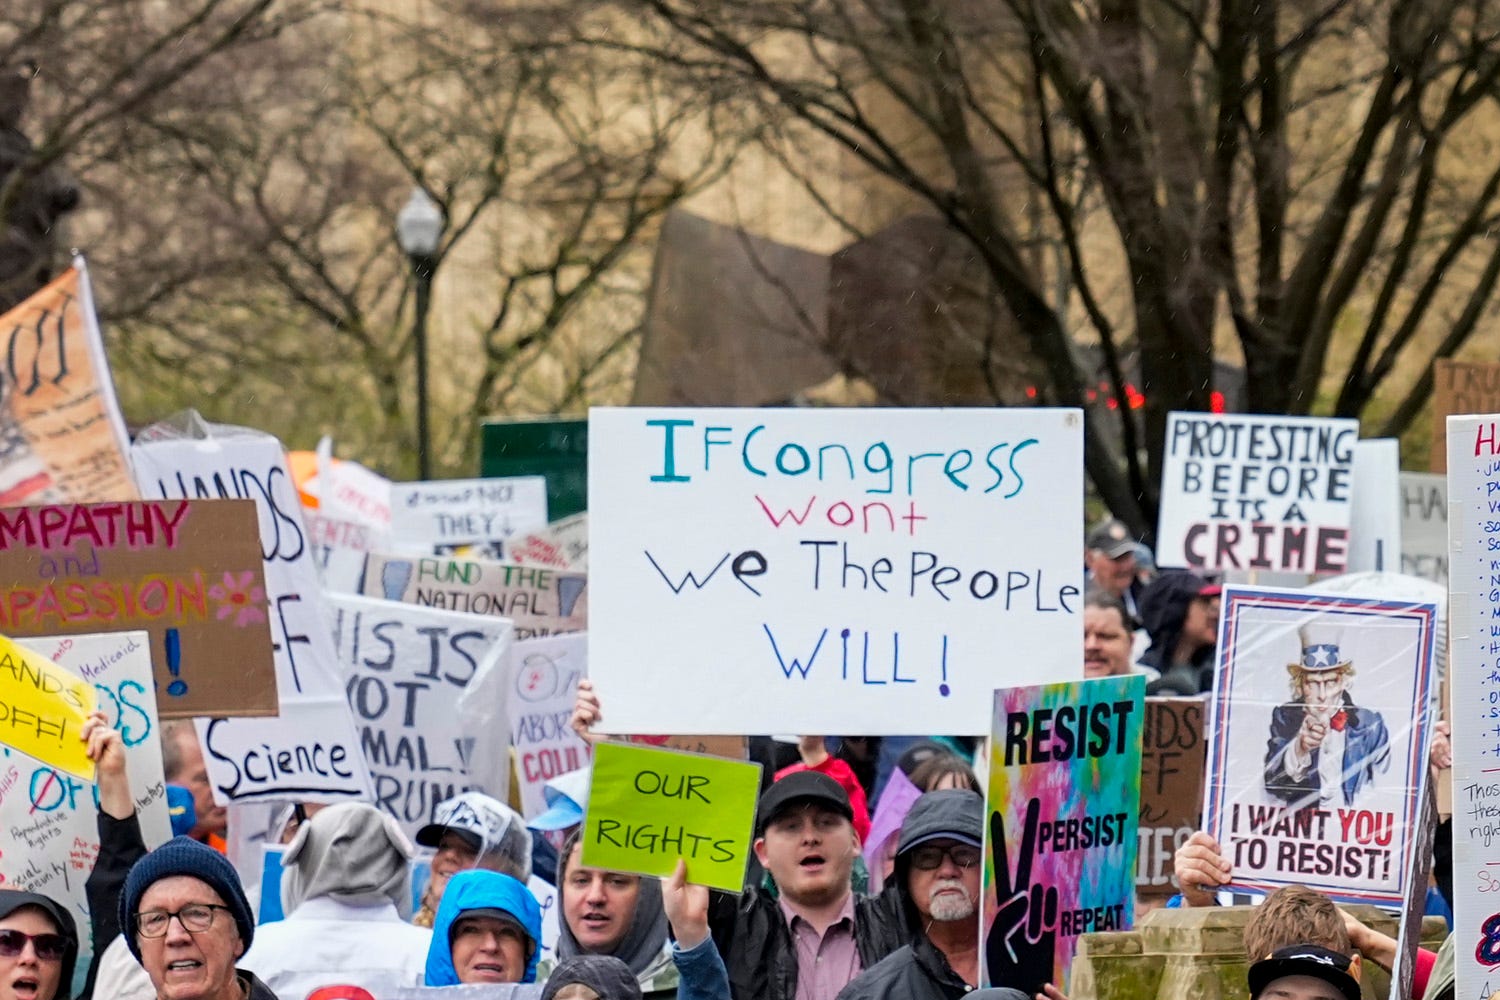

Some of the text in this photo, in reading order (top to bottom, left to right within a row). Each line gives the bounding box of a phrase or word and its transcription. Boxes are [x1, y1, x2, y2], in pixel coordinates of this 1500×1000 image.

[741, 424, 1040, 499] Congress
[1172, 420, 1357, 464] PROTESTING
[1183, 461, 1350, 502] BEFORE
[0, 500, 190, 549] MPATHY
[435, 512, 499, 537] THEY
[1282, 502, 1307, 522] A
[39, 548, 99, 578] and
[644, 541, 894, 598] We The
[1183, 522, 1349, 574] CRIME
[417, 558, 554, 591] FUND THE
[416, 588, 550, 617] NATIONAL
[78, 637, 142, 683] Medicaid
[413, 623, 487, 689] IS
[1003, 700, 1135, 767] RESIST
[206, 717, 354, 798] Science
[633, 769, 712, 805] OUR
[27, 826, 62, 850] Rights
[596, 818, 736, 864] RIGHTS
[1037, 812, 1129, 855] PERSIST
[1231, 803, 1393, 847] I WANT YOU
[1230, 836, 1268, 870] TO
[1276, 841, 1392, 881] RESIST!
[1059, 903, 1125, 938] REPEAT
